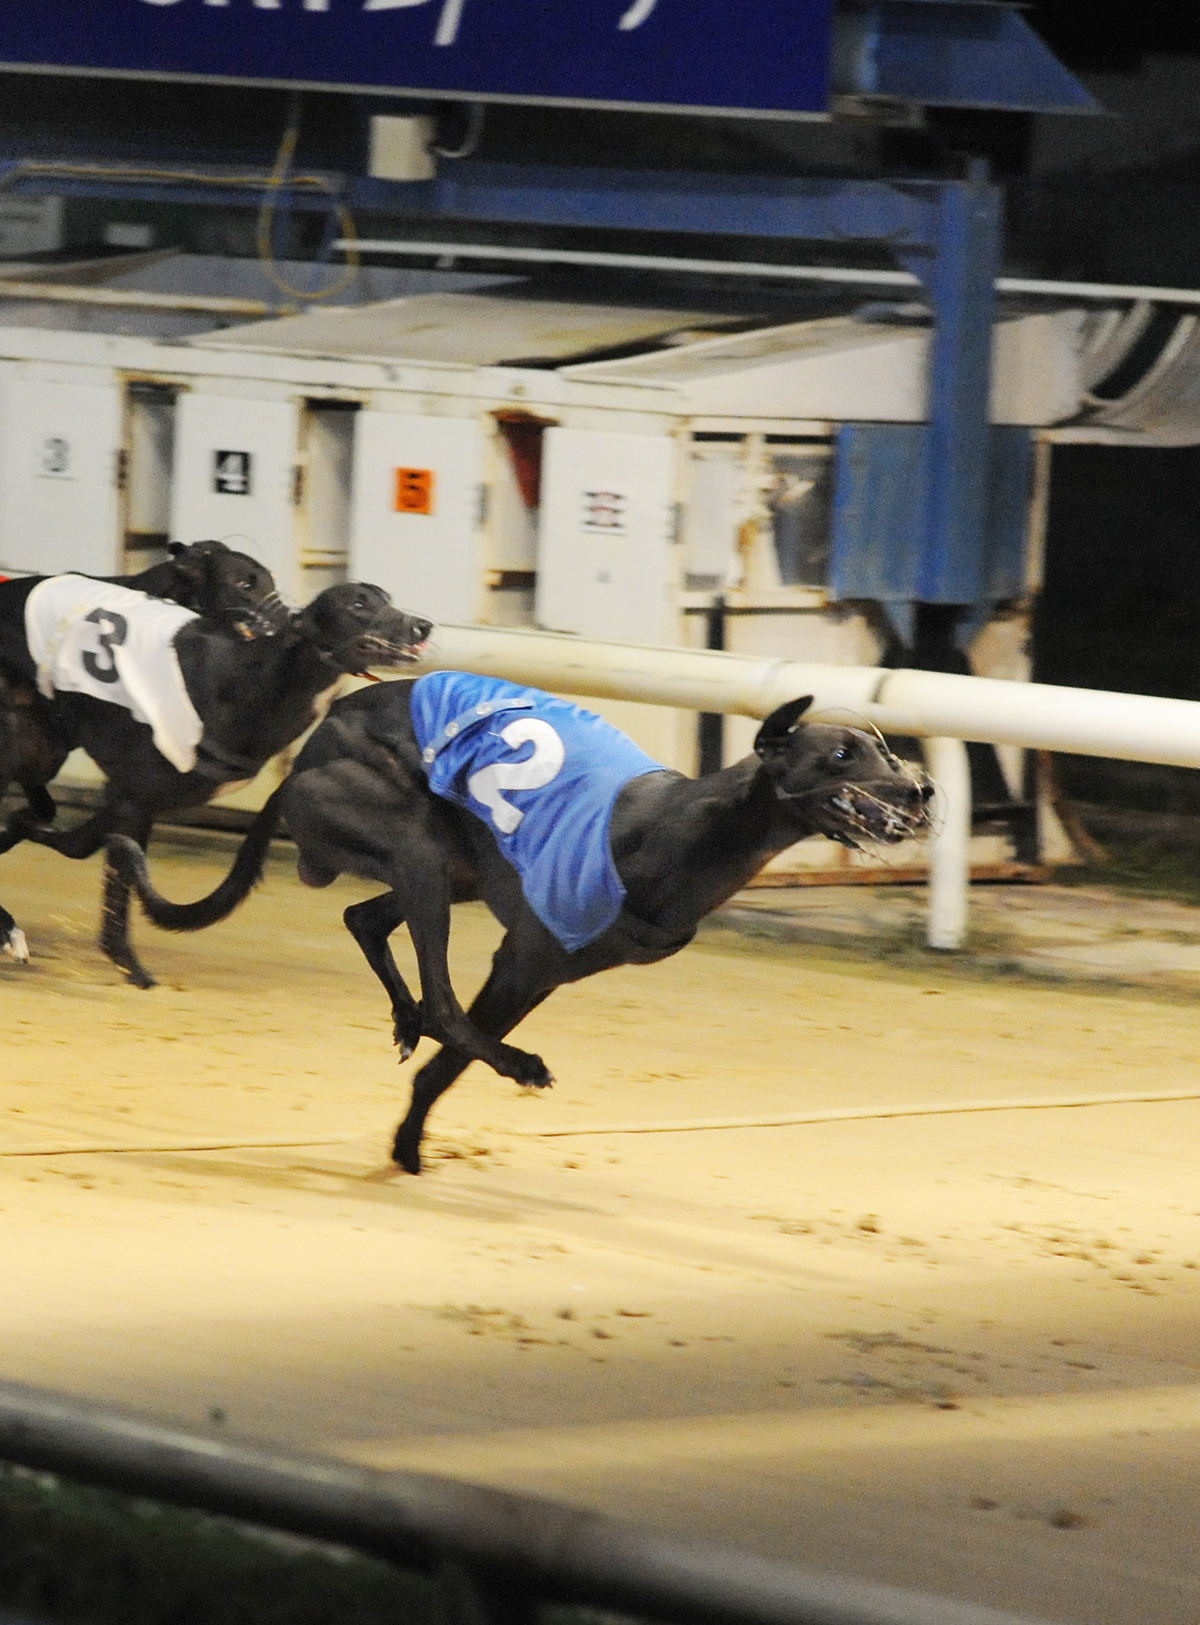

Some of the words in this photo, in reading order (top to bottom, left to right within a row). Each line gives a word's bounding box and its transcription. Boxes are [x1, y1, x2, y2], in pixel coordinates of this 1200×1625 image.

[42, 438, 70, 473] 3
[217, 454, 248, 491] 4
[402, 472, 428, 508] 5
[82, 607, 128, 684] 3
[468, 717, 565, 834] 2
